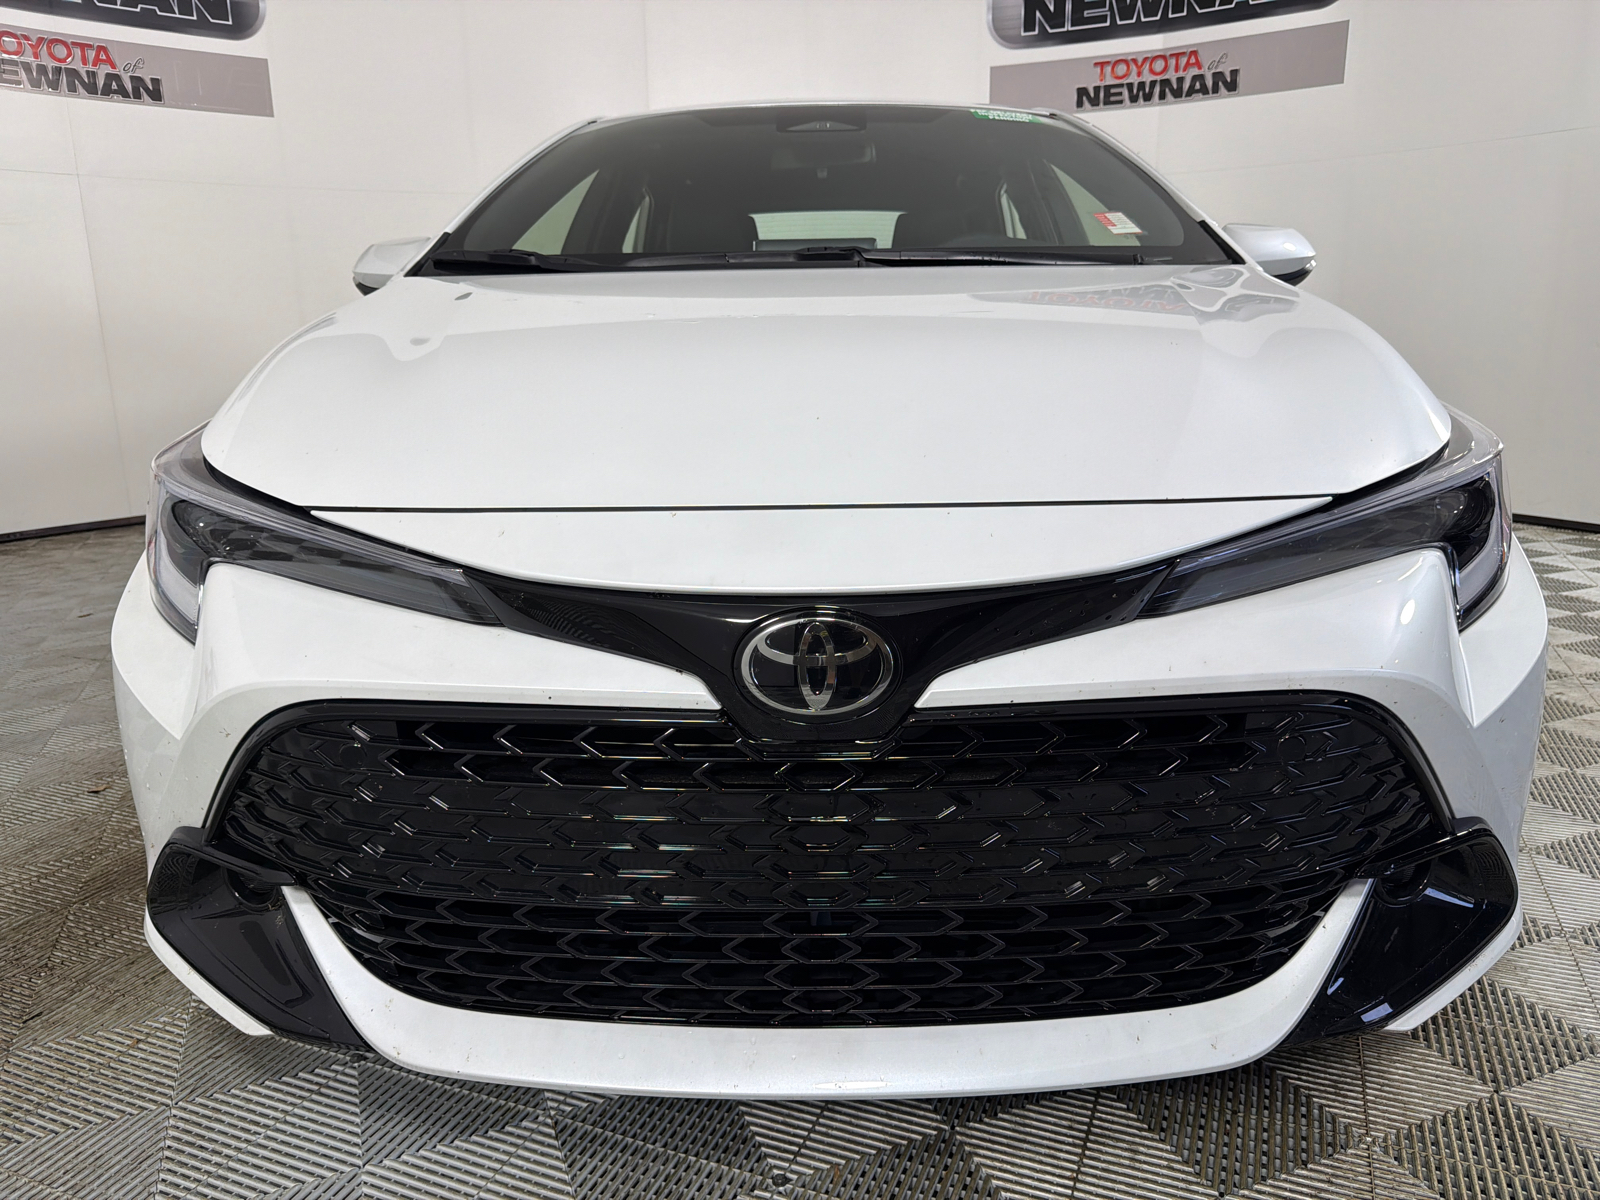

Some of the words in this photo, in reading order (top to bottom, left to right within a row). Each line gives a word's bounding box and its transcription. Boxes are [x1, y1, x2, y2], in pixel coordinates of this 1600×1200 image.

[0, 30, 118, 70] OYOTA
[122, 57, 145, 74] of
[1093, 49, 1203, 82] TOYOTA
[1207, 52, 1229, 71] of
[0, 58, 164, 103] EWNAN
[1075, 68, 1240, 109] NEWNAN
